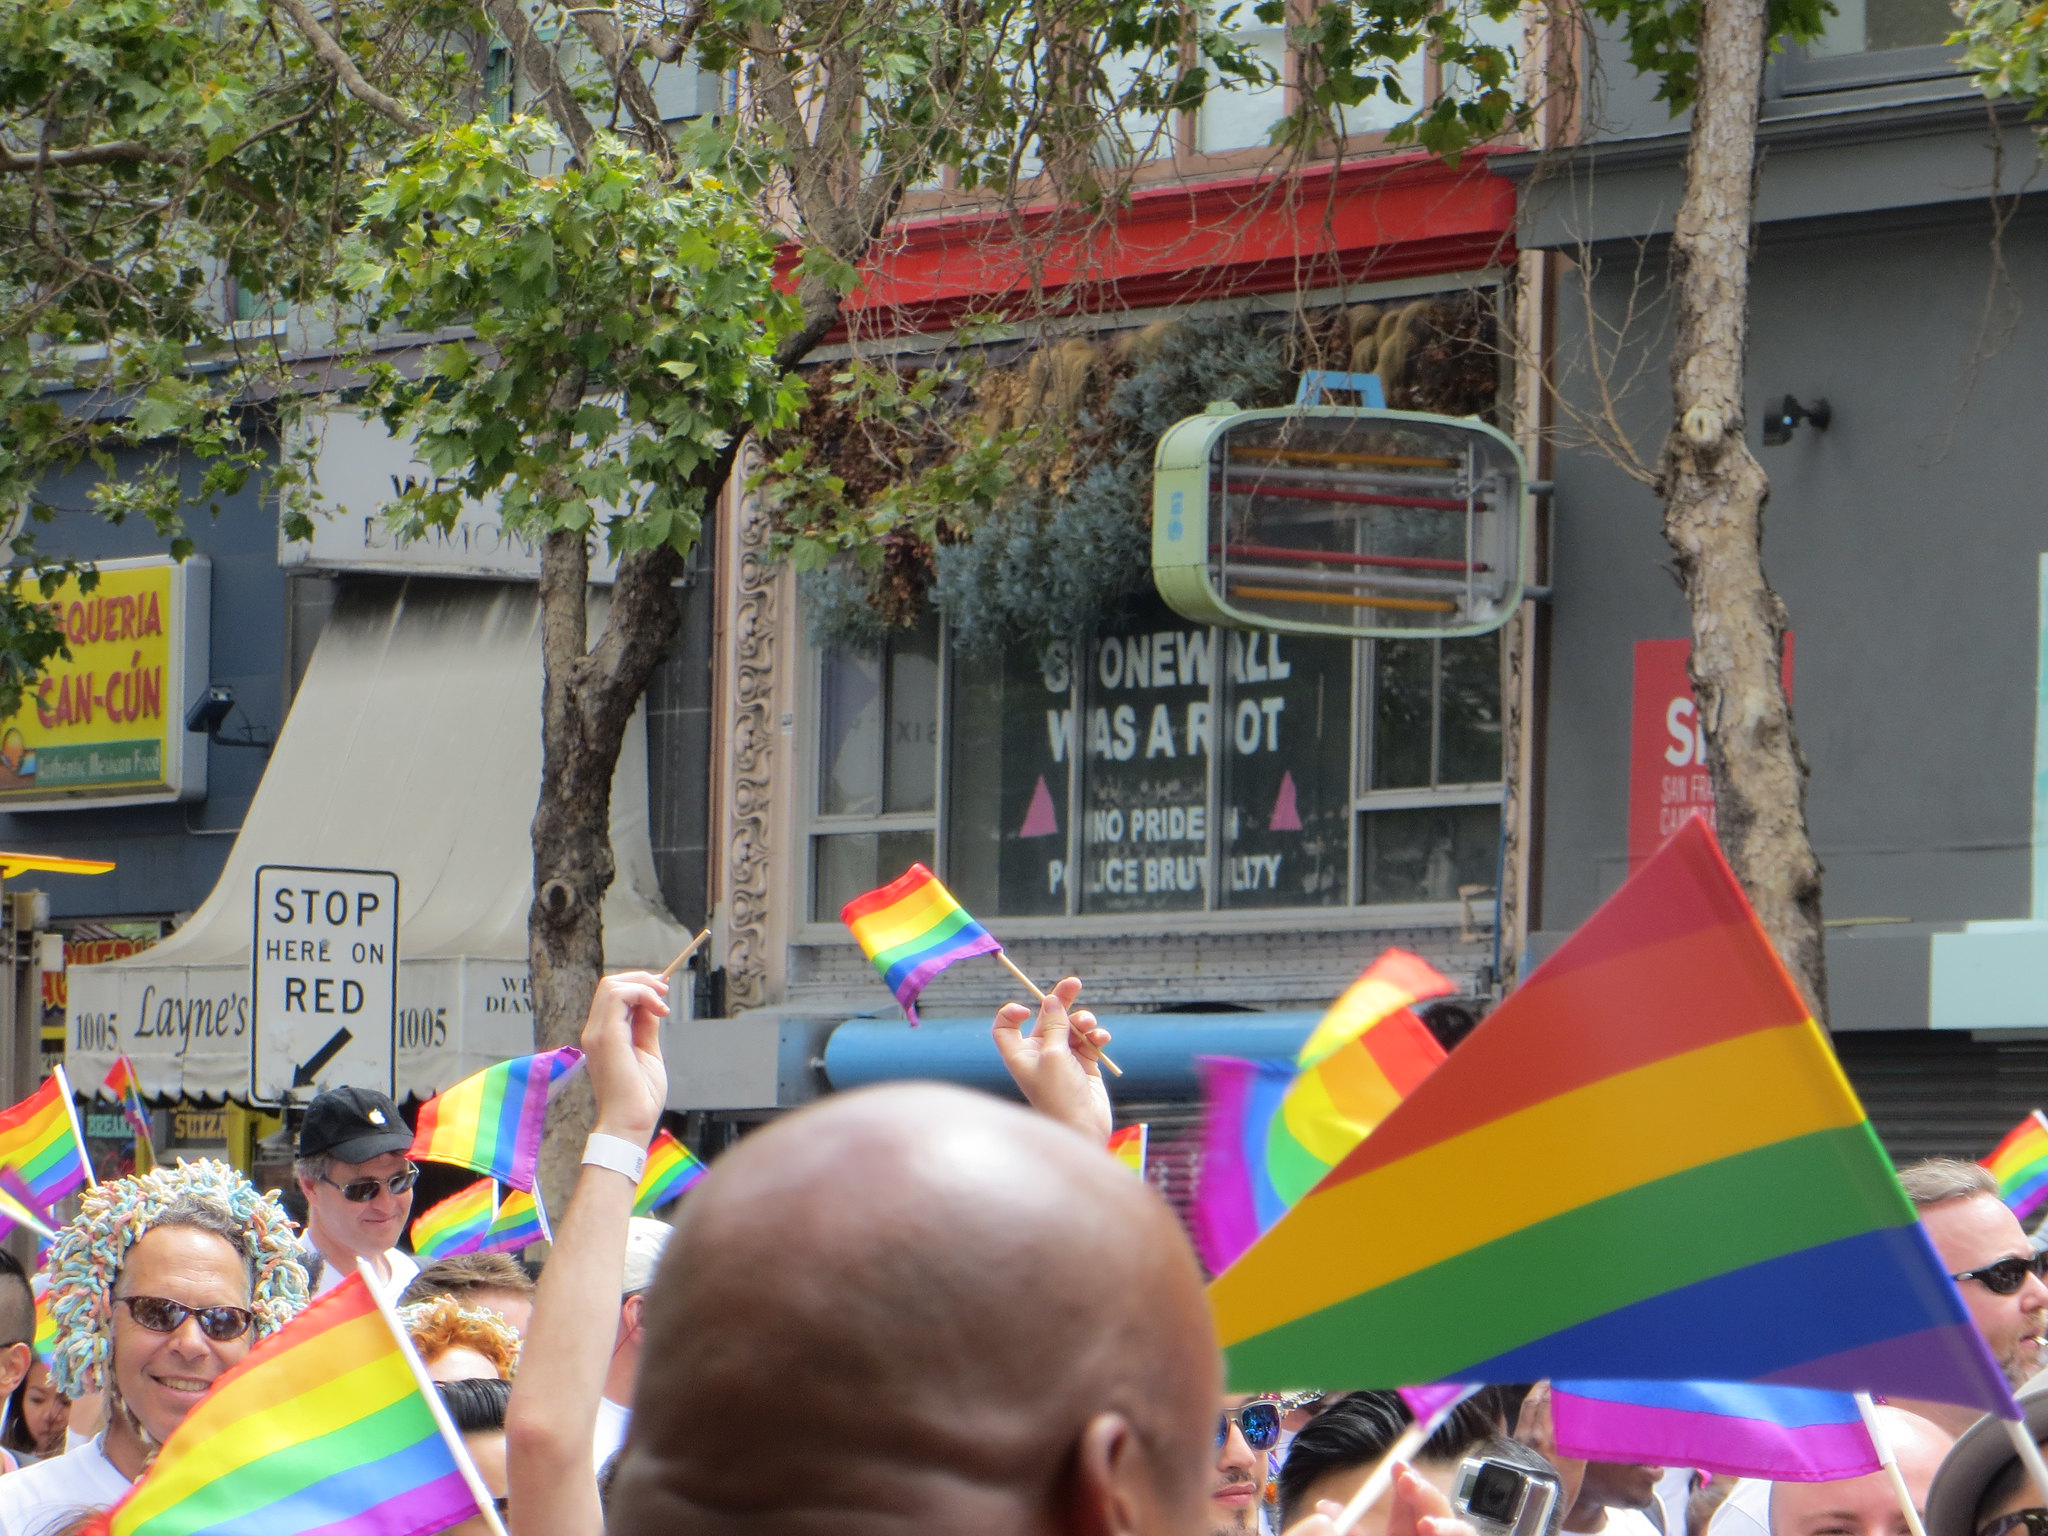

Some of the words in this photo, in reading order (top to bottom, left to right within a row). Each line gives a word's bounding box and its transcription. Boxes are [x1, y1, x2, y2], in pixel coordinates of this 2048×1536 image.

[1042, 630, 1291, 693] SONEWALL
[1046, 704, 1137, 762] WAS
[1146, 703, 1176, 759] A
[1186, 697, 1285, 756] ROT
[1130, 806, 1205, 843] PRIDE
[1049, 858, 1139, 895] PLICE
[1143, 855, 1283, 893] BRUTLITY
[273, 887, 380, 928] STOP
[266, 939, 332, 963] HERE
[351, 942, 385, 965] ON
[285, 977, 365, 1015] RED
[76, 1012, 118, 1052] 1005
[134, 984, 249, 1058] Layne's
[399, 1007, 448, 1049] 1005
